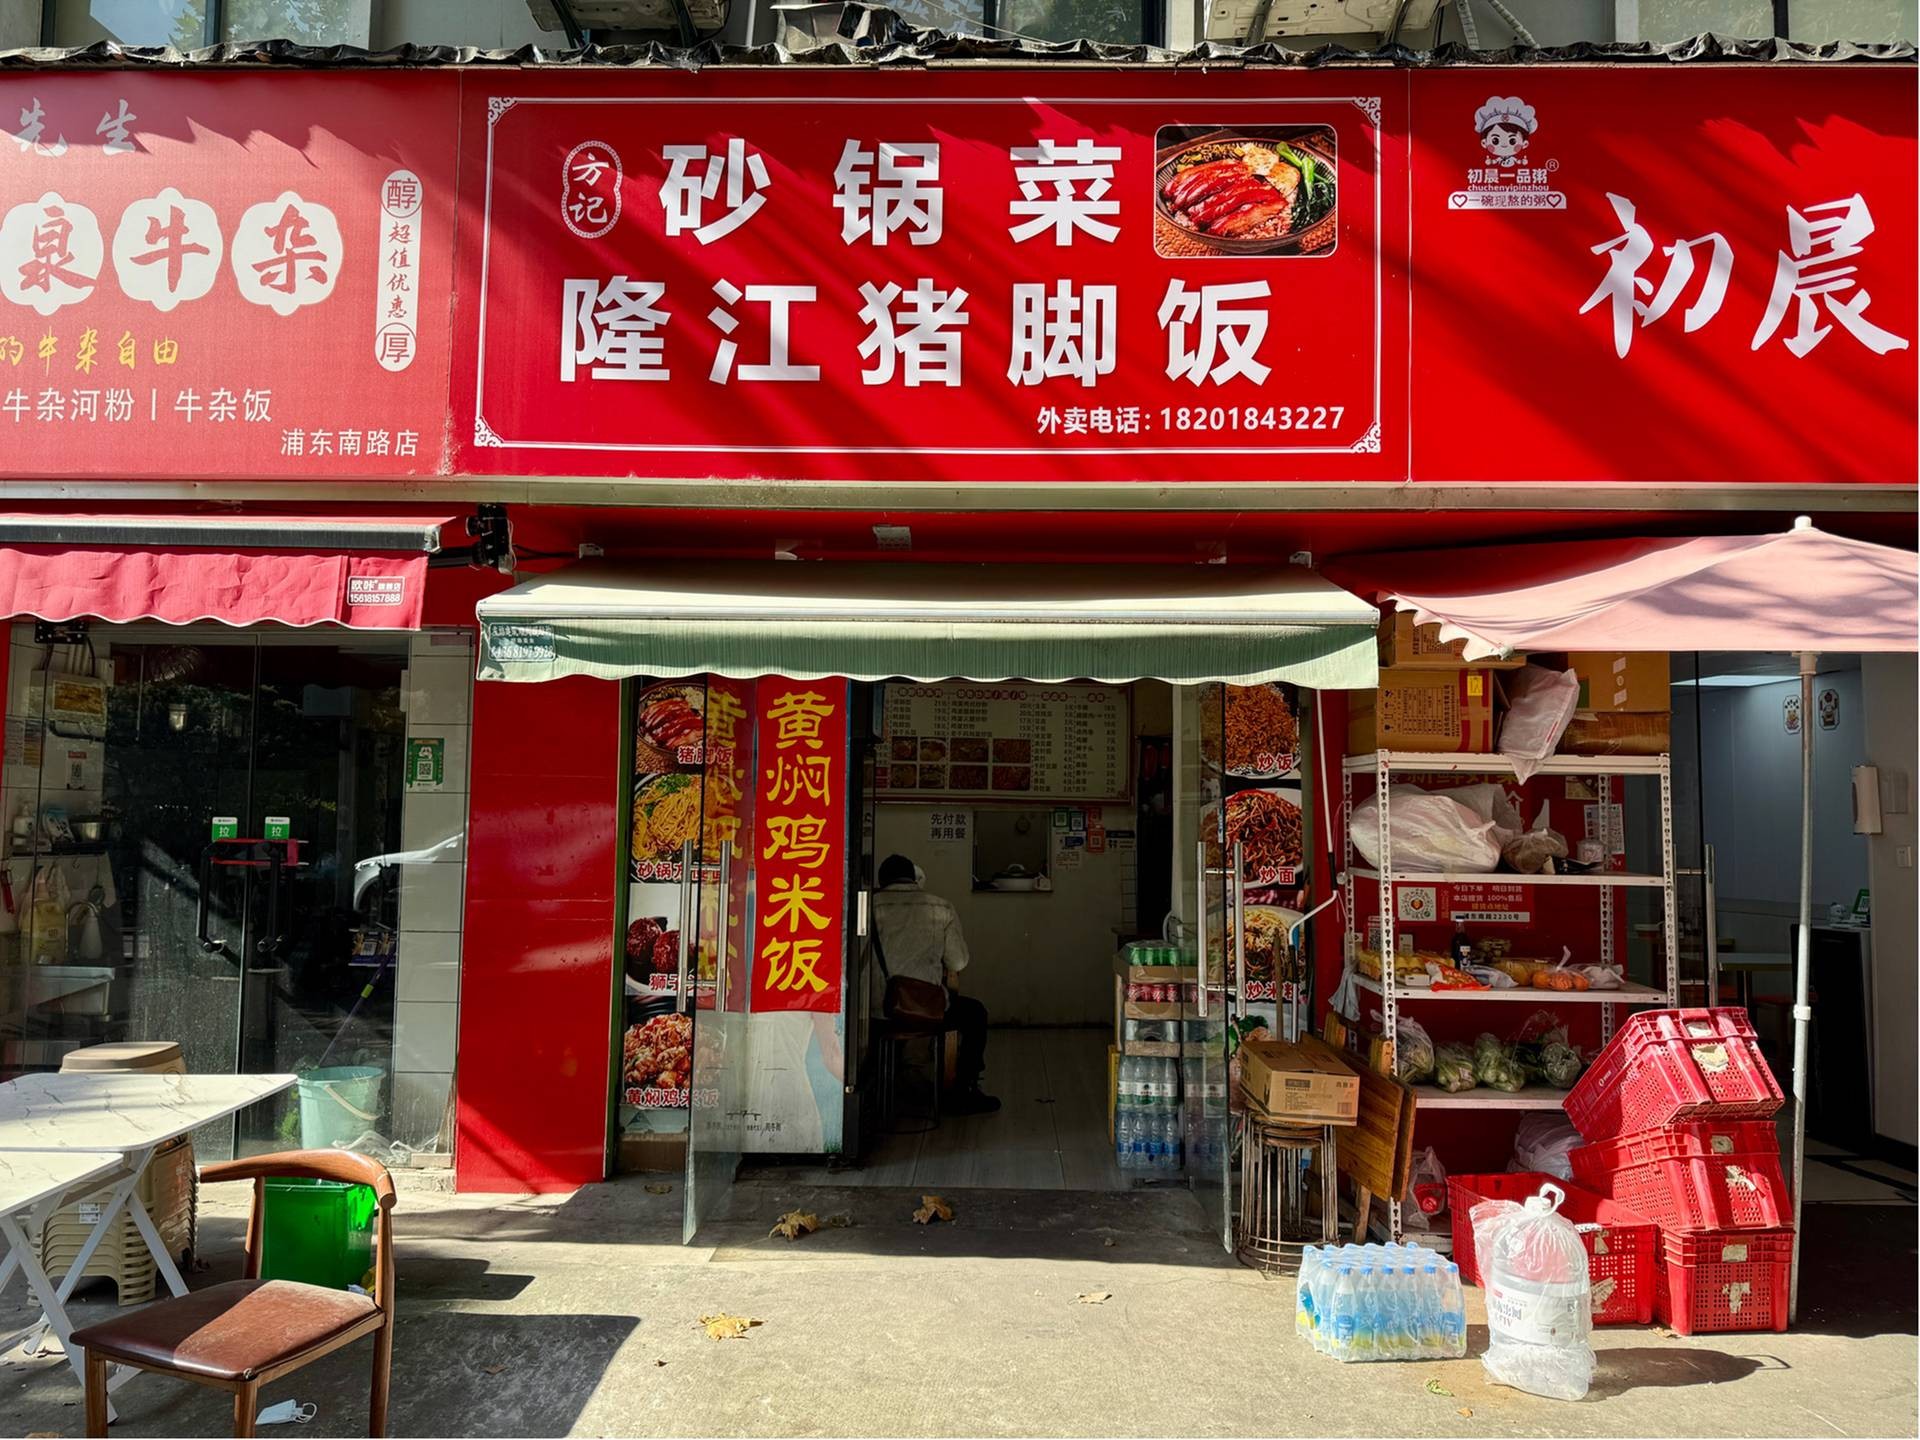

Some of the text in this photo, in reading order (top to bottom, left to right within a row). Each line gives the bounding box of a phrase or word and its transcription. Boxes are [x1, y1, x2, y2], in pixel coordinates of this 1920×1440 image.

[13, 97, 138, 156] 先生
[570, 153, 609, 225] 方记
[1467, 168, 1548, 184] 初晨一品粥
[386, 177, 418, 209] 醇
[659, 138, 1122, 246] 砂锅菜
[386, 220, 413, 320] 超值优惠
[1578, 191, 1910, 360] 初晨
[560, 275, 1272, 388] 隆江猪脚饭
[379, 334, 410, 364] 厚
[280, 428, 419, 457] 浦东南路店
[677, 745, 734, 765] 猪脚饭
[1258, 752, 1294, 772] 炒饭
[931, 813, 967, 826] 先付款
[931, 827, 966, 839] 再用餐
[762, 690, 836, 994] 黄焖鸡米饭
[1260, 866, 1296, 885] 炒面
[626, 1087, 719, 1107] 黄焖鸡米饭
